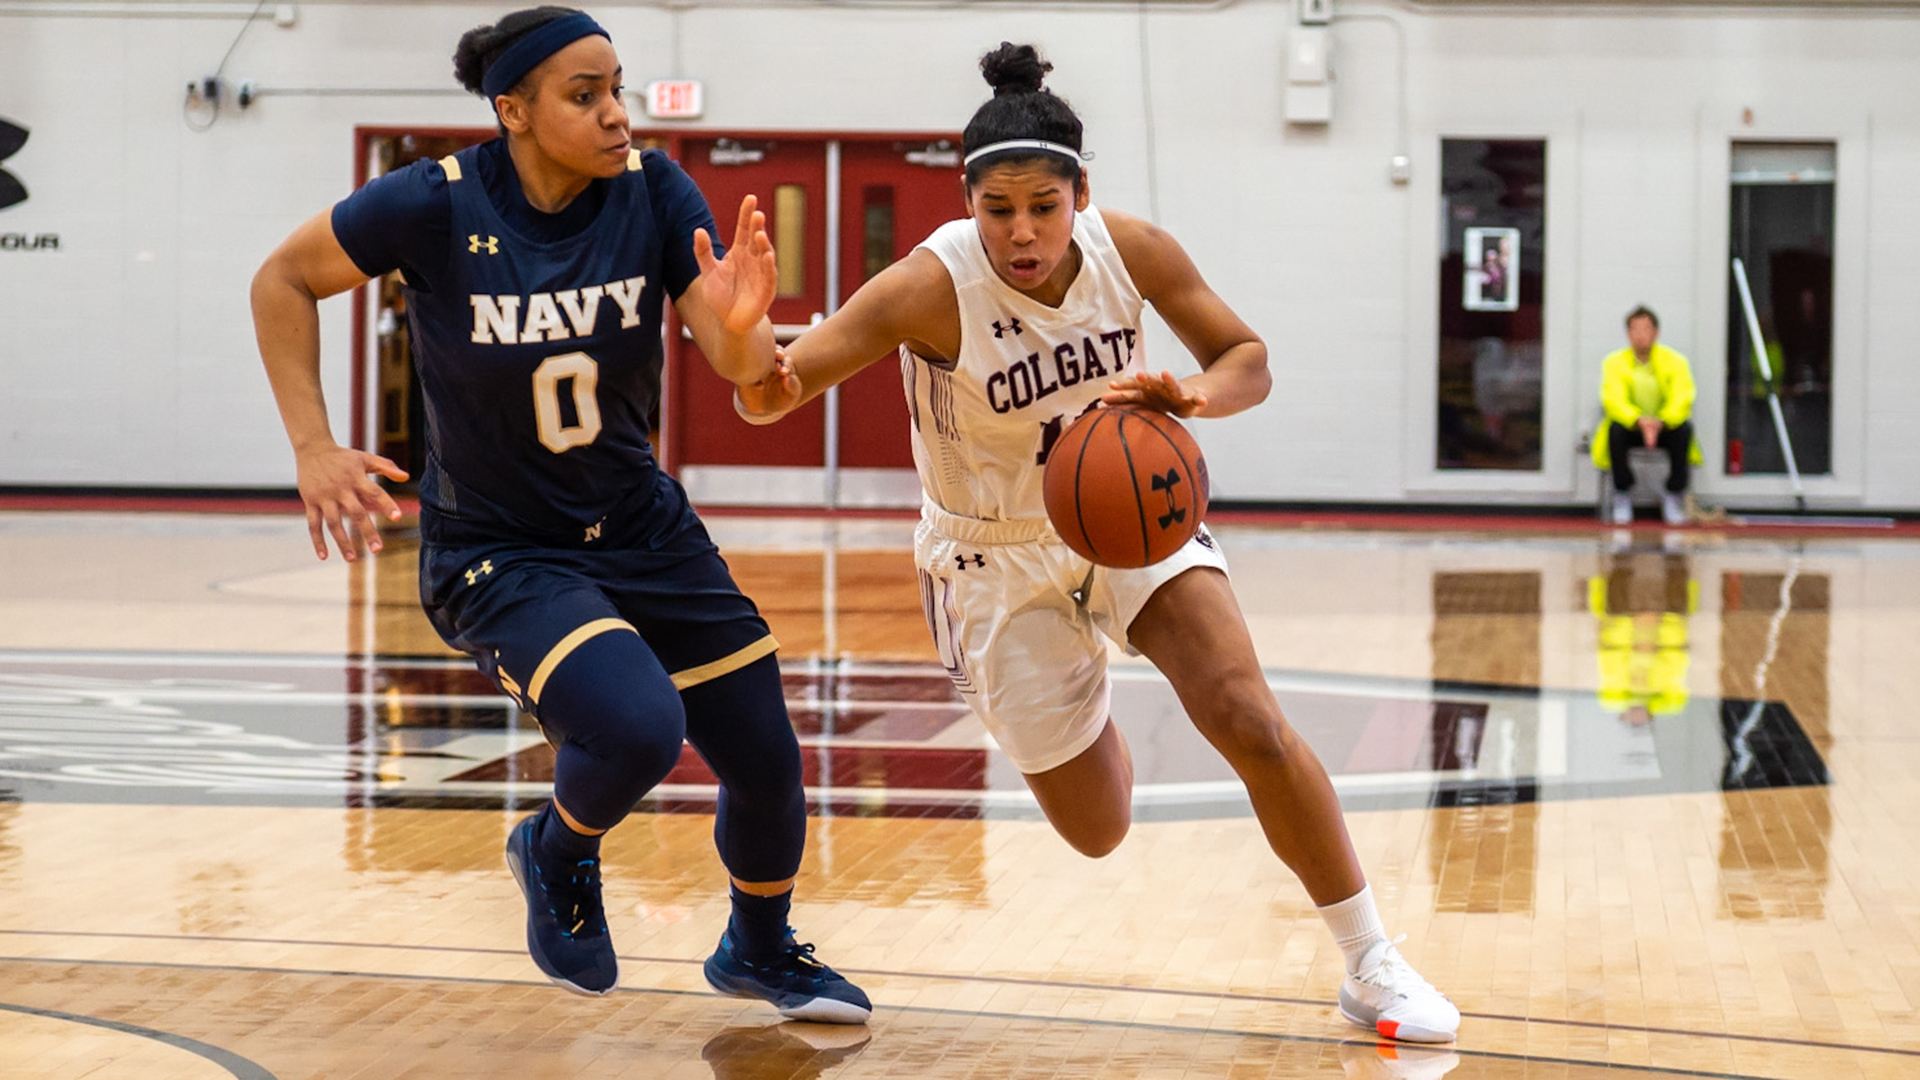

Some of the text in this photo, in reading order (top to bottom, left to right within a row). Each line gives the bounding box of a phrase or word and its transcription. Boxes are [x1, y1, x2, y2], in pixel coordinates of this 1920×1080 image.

[656, 82, 694, 112] EXIT
[469, 275, 647, 345] NAVY
[532, 351, 603, 454] 0
